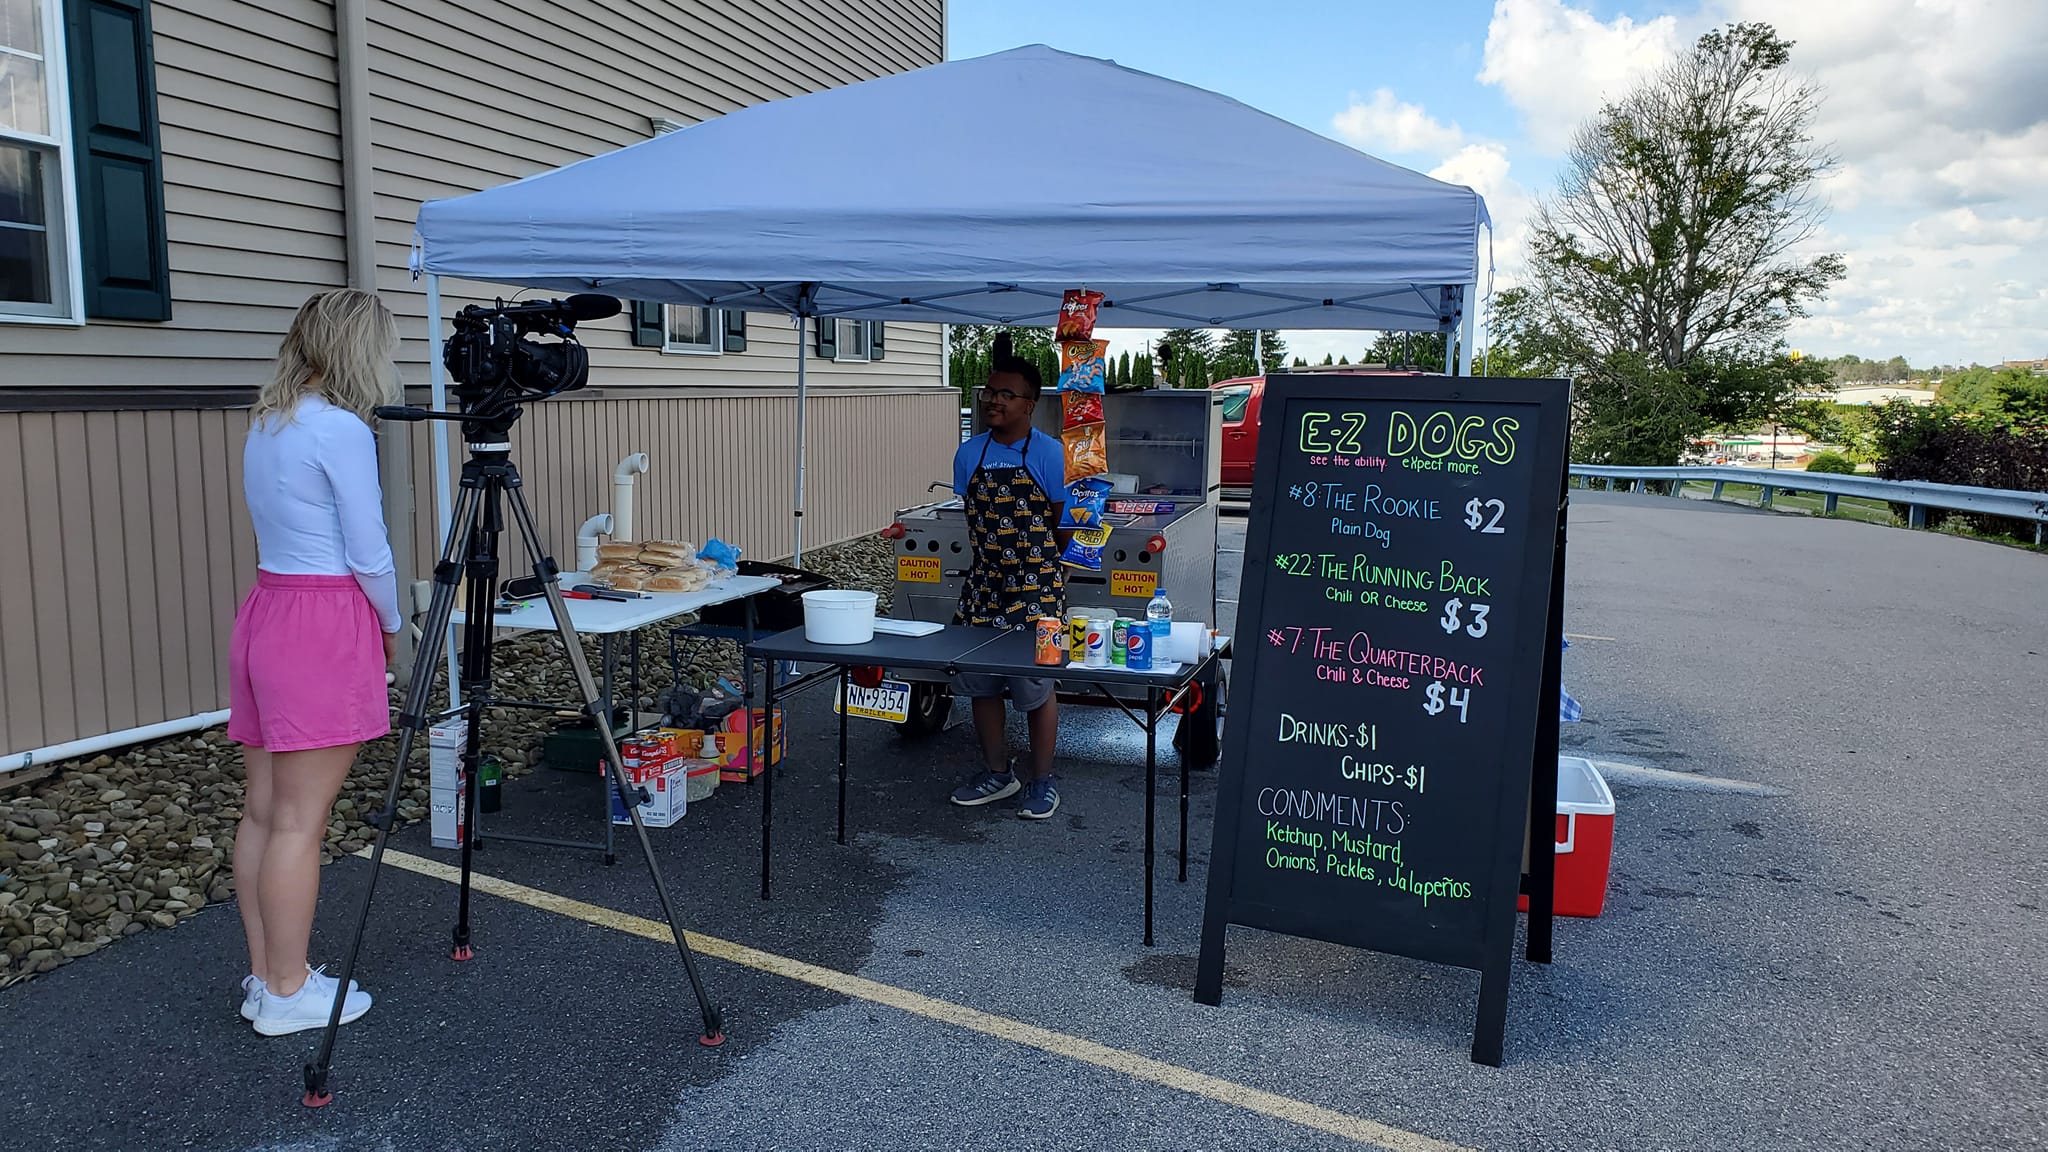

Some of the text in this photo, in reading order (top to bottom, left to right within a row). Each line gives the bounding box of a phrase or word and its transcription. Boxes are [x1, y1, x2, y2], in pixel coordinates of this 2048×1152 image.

[1300, 411, 1520, 465] E-Z DOGS
[1310, 455, 1328, 466] see
[1333, 454, 1351, 467] the
[1447, 460, 1482, 475] more.
[1072, 488, 1099, 497] Doritos
[1363, 484, 1442, 520] ROOKIE
[1464, 497, 1505, 534] $2
[1331, 518, 1391, 549] Plain Dog
[900, 559, 939, 568] CAUTION
[910, 571, 929, 579] HOT
[1113, 573, 1155, 582] CAUTION
[1352, 554, 1435, 590] RUNNING
[1439, 560, 1491, 597] BACK
[1124, 585, 1144, 593] HOT
[1325, 586, 1428, 614] Chili OR Cheese
[1440, 598, 1490, 639] $3
[1348, 632, 1484, 687] QUARTERBACK
[1316, 665, 1411, 690] Chili & Cheese
[855, 707, 886, 716] TRAILER
[1422, 681, 1470, 723] $4
[1258, 787, 1412, 835] CONDIMENTS:
[1267, 820, 1404, 868] Ketchup, Mustard,
[1266, 848, 1320, 874] Onions,
[1388, 869, 1472, 907] Jalapeños
